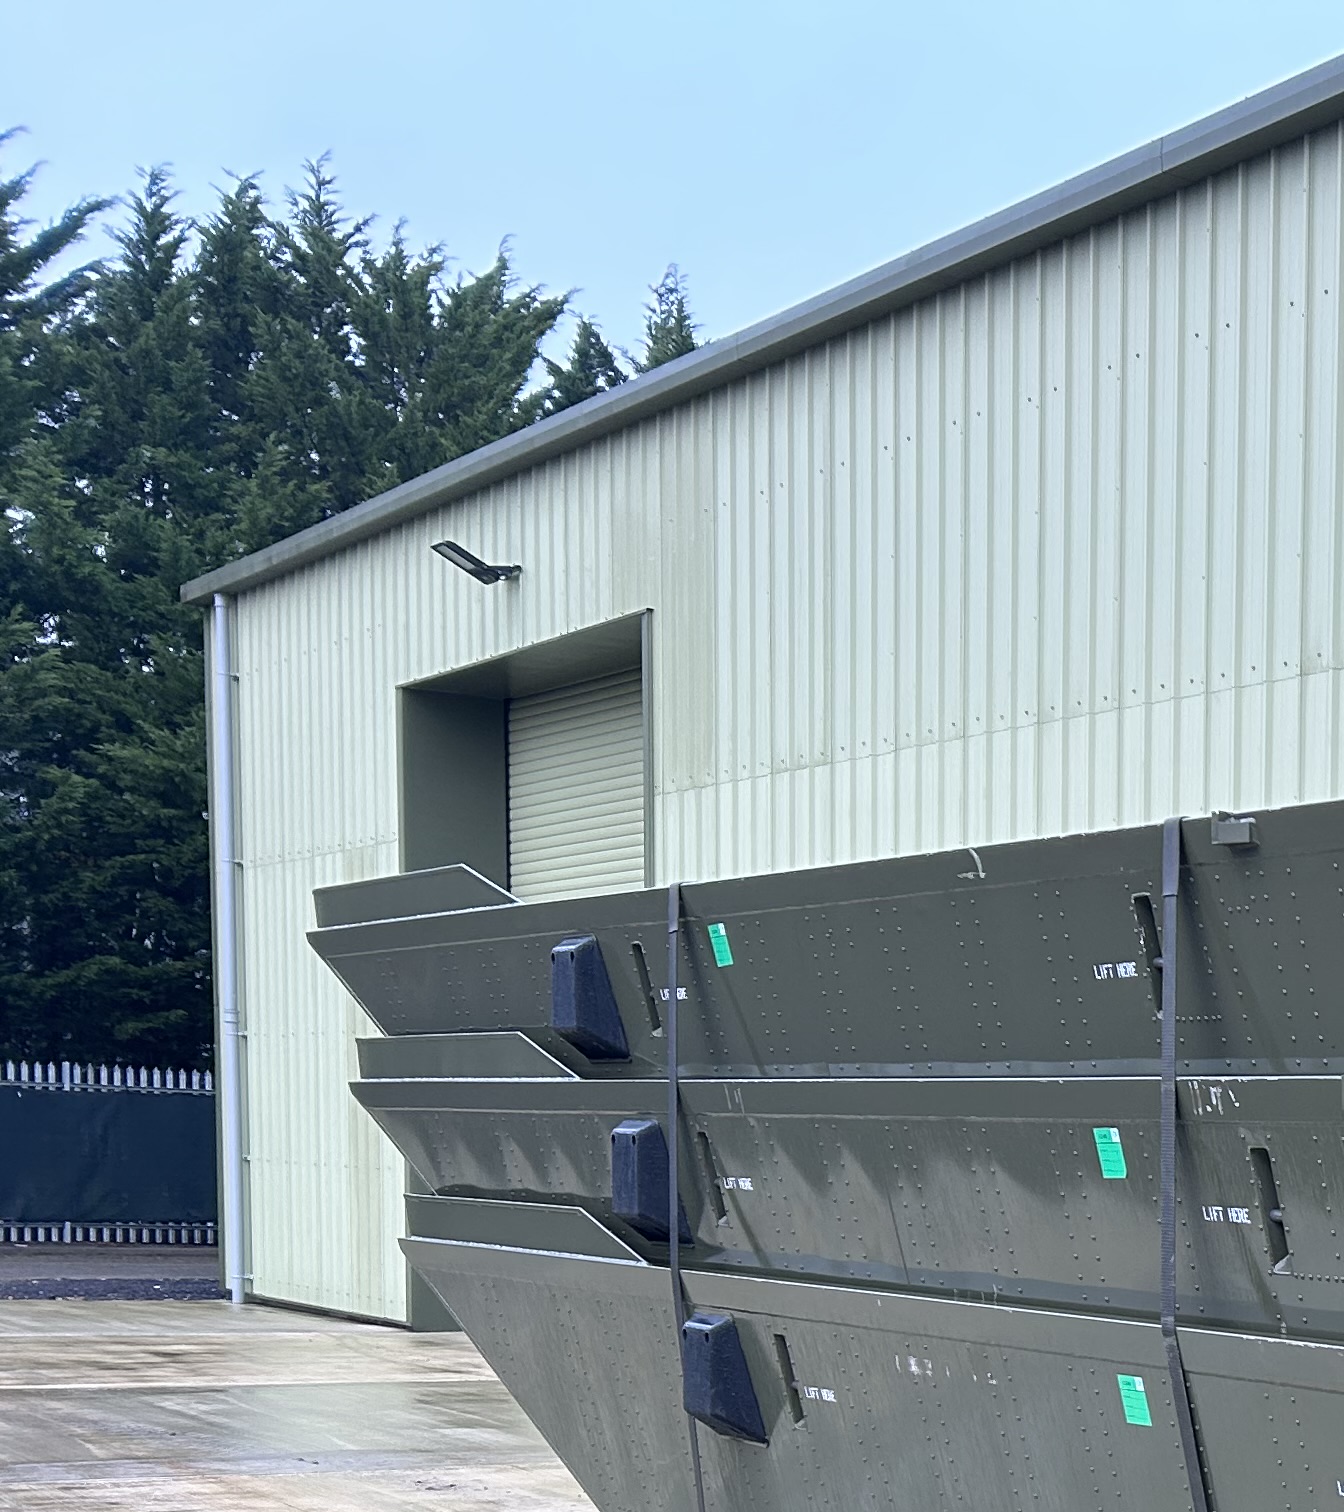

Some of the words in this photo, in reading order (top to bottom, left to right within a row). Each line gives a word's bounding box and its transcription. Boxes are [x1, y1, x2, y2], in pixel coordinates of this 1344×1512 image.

[1092, 964, 1114, 980] LIFT
[1115, 961, 1138, 979] HERE
[1201, 1205, 1224, 1222] LIFT
[1226, 1207, 1252, 1225] HERE
